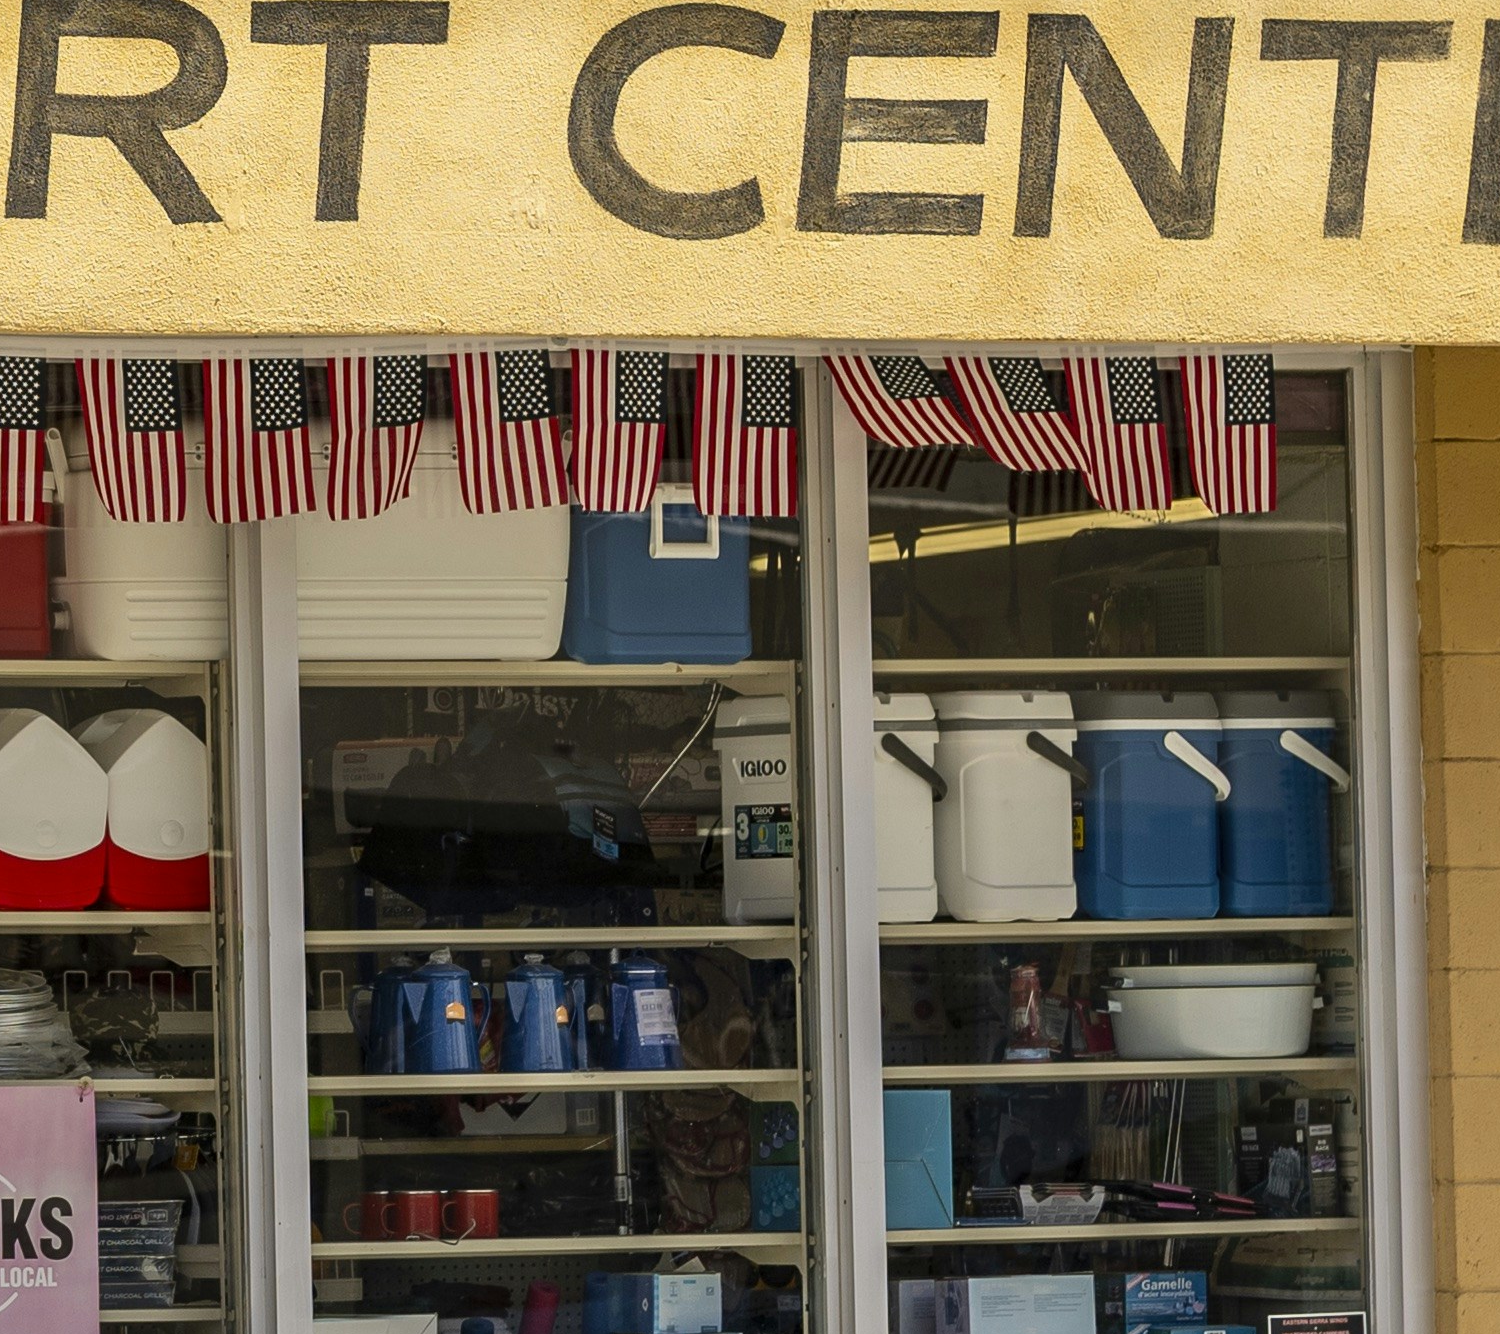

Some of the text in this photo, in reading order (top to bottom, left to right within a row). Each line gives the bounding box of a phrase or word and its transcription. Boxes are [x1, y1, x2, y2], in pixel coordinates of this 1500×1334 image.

[741, 759, 787, 777] IGLOO
[736, 812, 749, 841] 3
[0, 1267, 58, 1289] LOCAL
[1141, 1277, 1193, 1291] Gamelle
